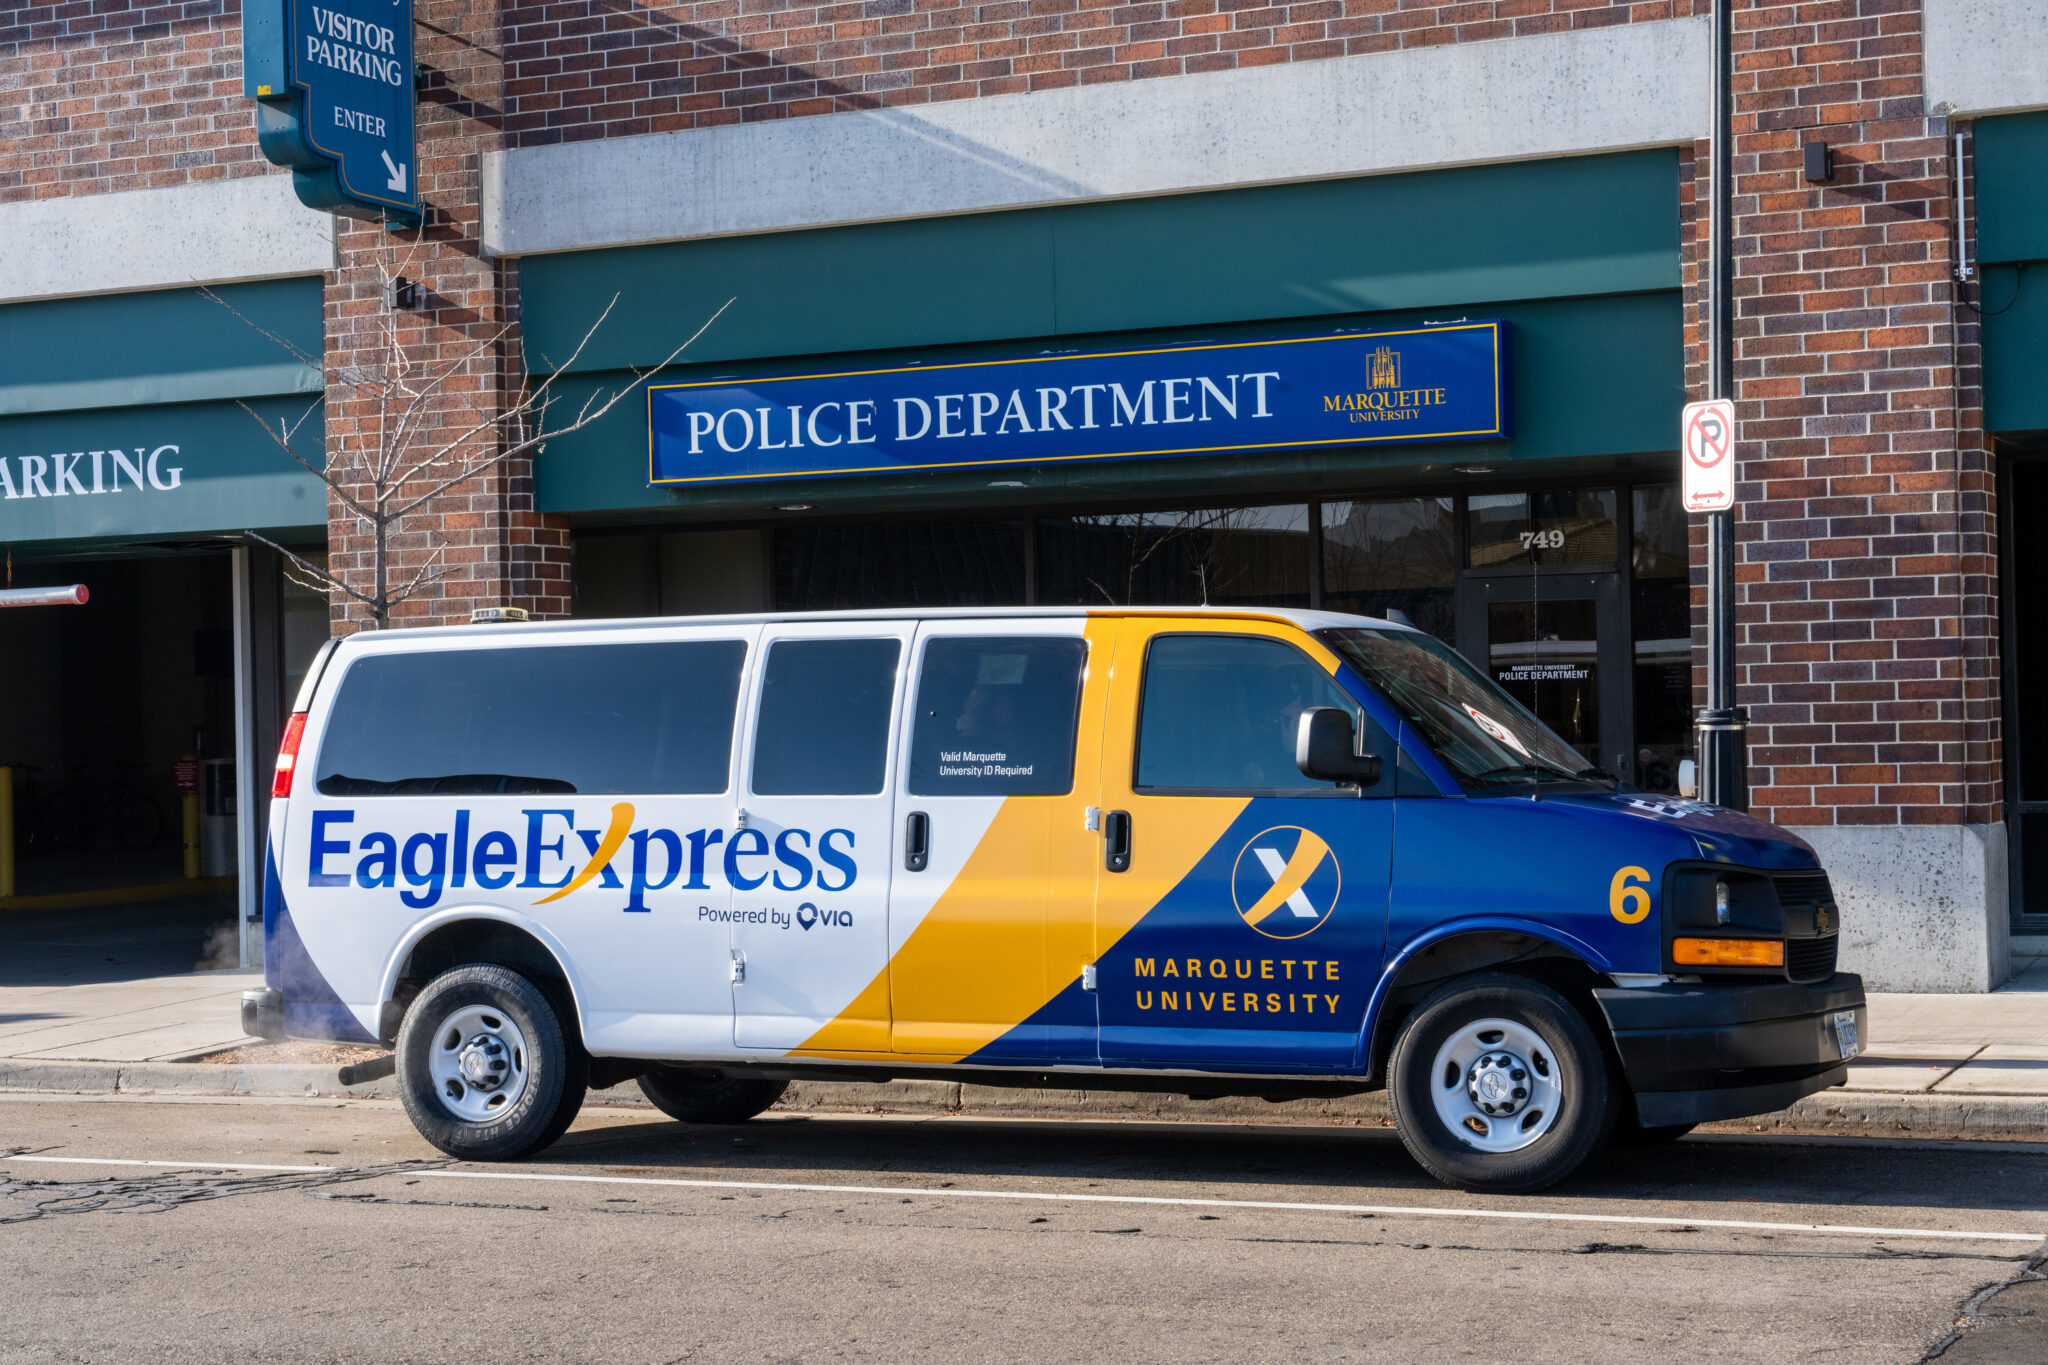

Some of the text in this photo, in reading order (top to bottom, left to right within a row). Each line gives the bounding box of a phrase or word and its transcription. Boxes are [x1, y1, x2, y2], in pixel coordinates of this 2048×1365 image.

[312, 6, 395, 55] VISITOR
[307, 36, 402, 86] PARKING
[334, 106, 386, 137] ENTER
[1323, 388, 1446, 412] MARQUETTE
[686, 371, 1280, 455] POLICE DEPARTMENT
[1350, 409, 1420, 423] UNIVERSITY
[0, 445, 183, 499] ARKING
[1519, 530, 1565, 550] 749
[1499, 670, 1588, 680] POLICE DEPARTMENT
[940, 751, 1006, 763] Valid Marquette
[940, 764, 1033, 777] University ID Required
[1609, 866, 1651, 924] 6
[698, 906, 767, 924] Powered
[771, 908, 791, 930] by
[1134, 958, 1340, 980] MARQUETTE
[1136, 991, 1340, 1013] UNIVERSITY
